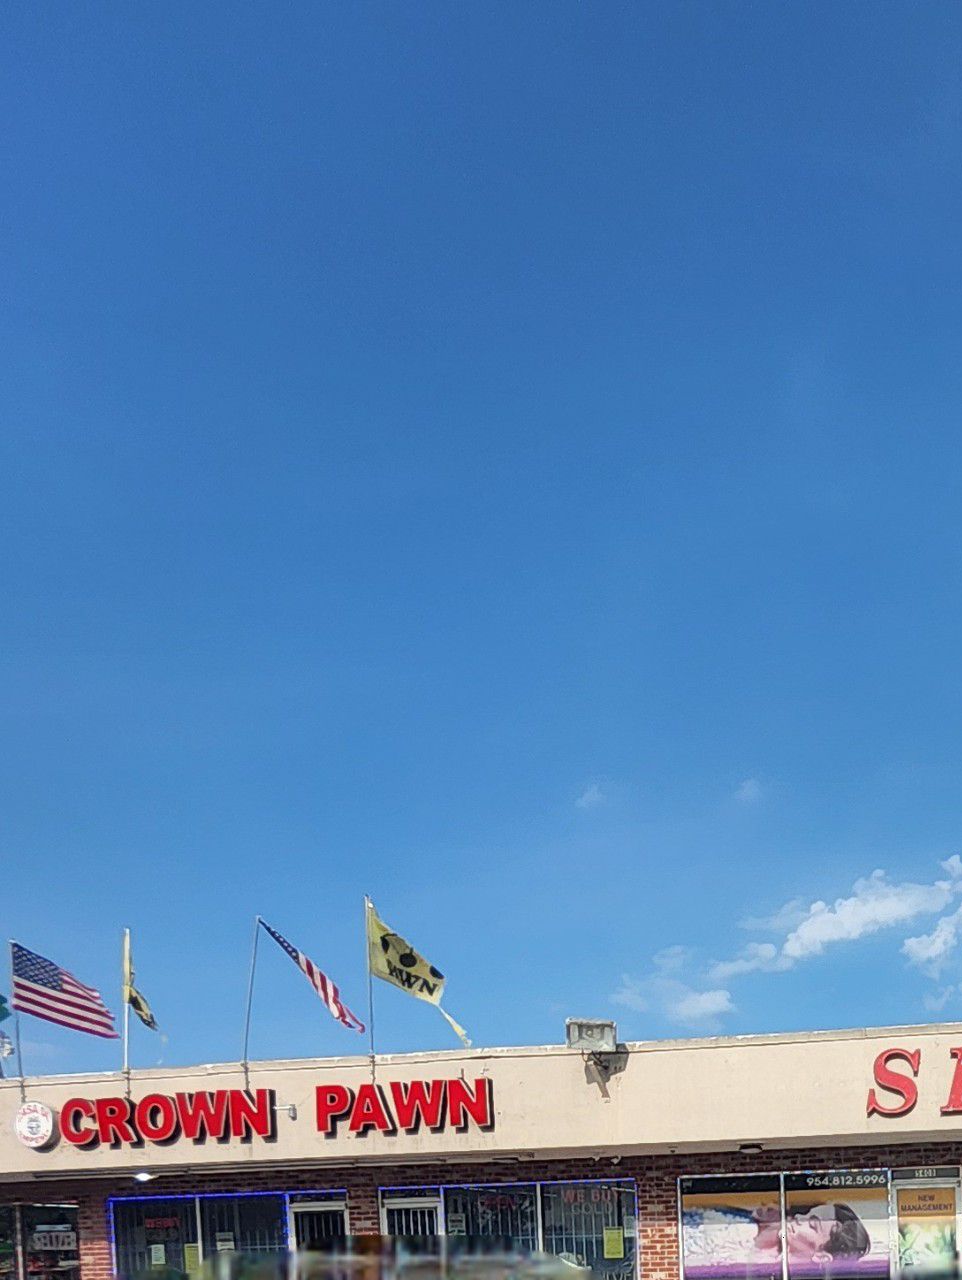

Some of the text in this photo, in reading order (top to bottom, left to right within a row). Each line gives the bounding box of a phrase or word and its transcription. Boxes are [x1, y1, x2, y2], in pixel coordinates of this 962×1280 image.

[59, 1078, 492, 1145] CROWN PAWN
[806, 1174, 887, 1187] 954.812.5996
[917, 1194, 936, 1202] NEW
[900, 1203, 953, 1212] MANAGEMENT
